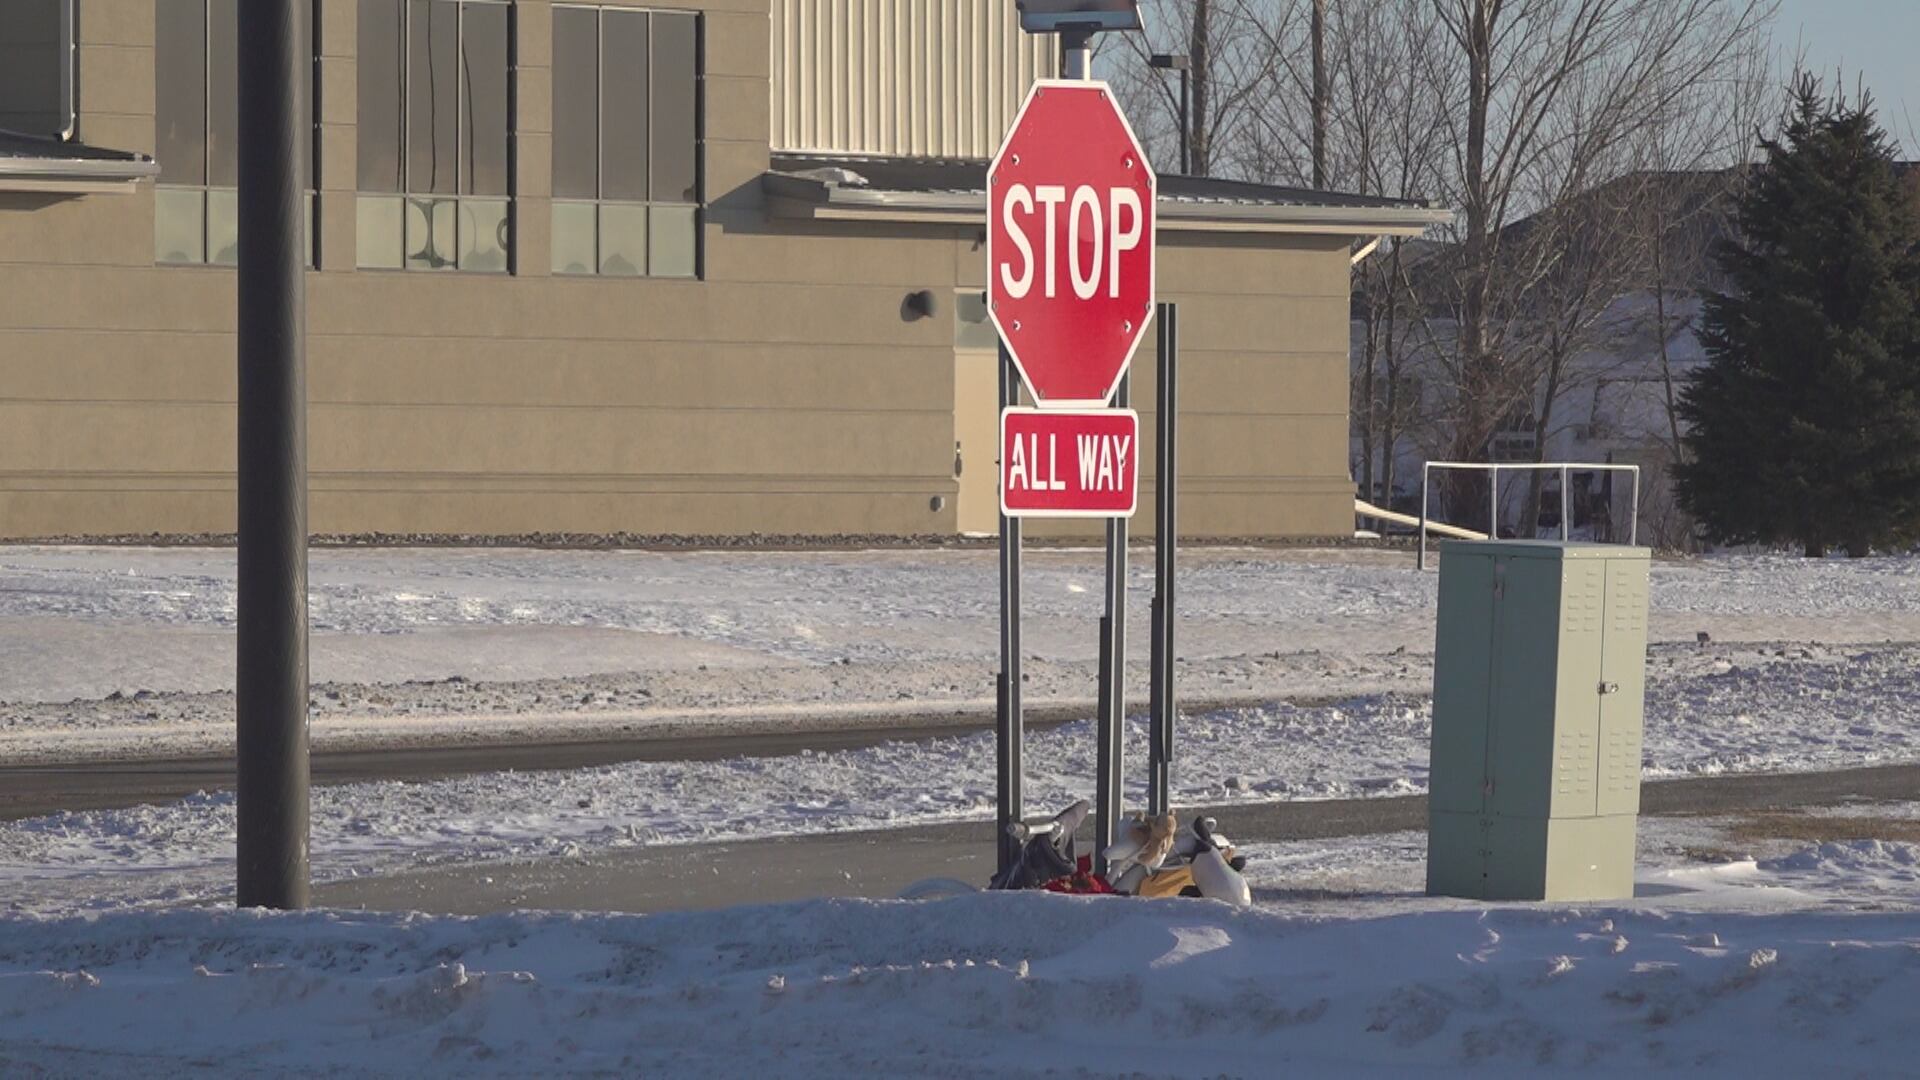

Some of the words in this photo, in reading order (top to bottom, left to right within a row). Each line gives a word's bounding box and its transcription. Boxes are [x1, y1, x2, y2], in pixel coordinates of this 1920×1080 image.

[1000, 184, 1143, 299] STOP
[1008, 432, 1066, 491] ALL
[1076, 434, 1131, 491] WAY
